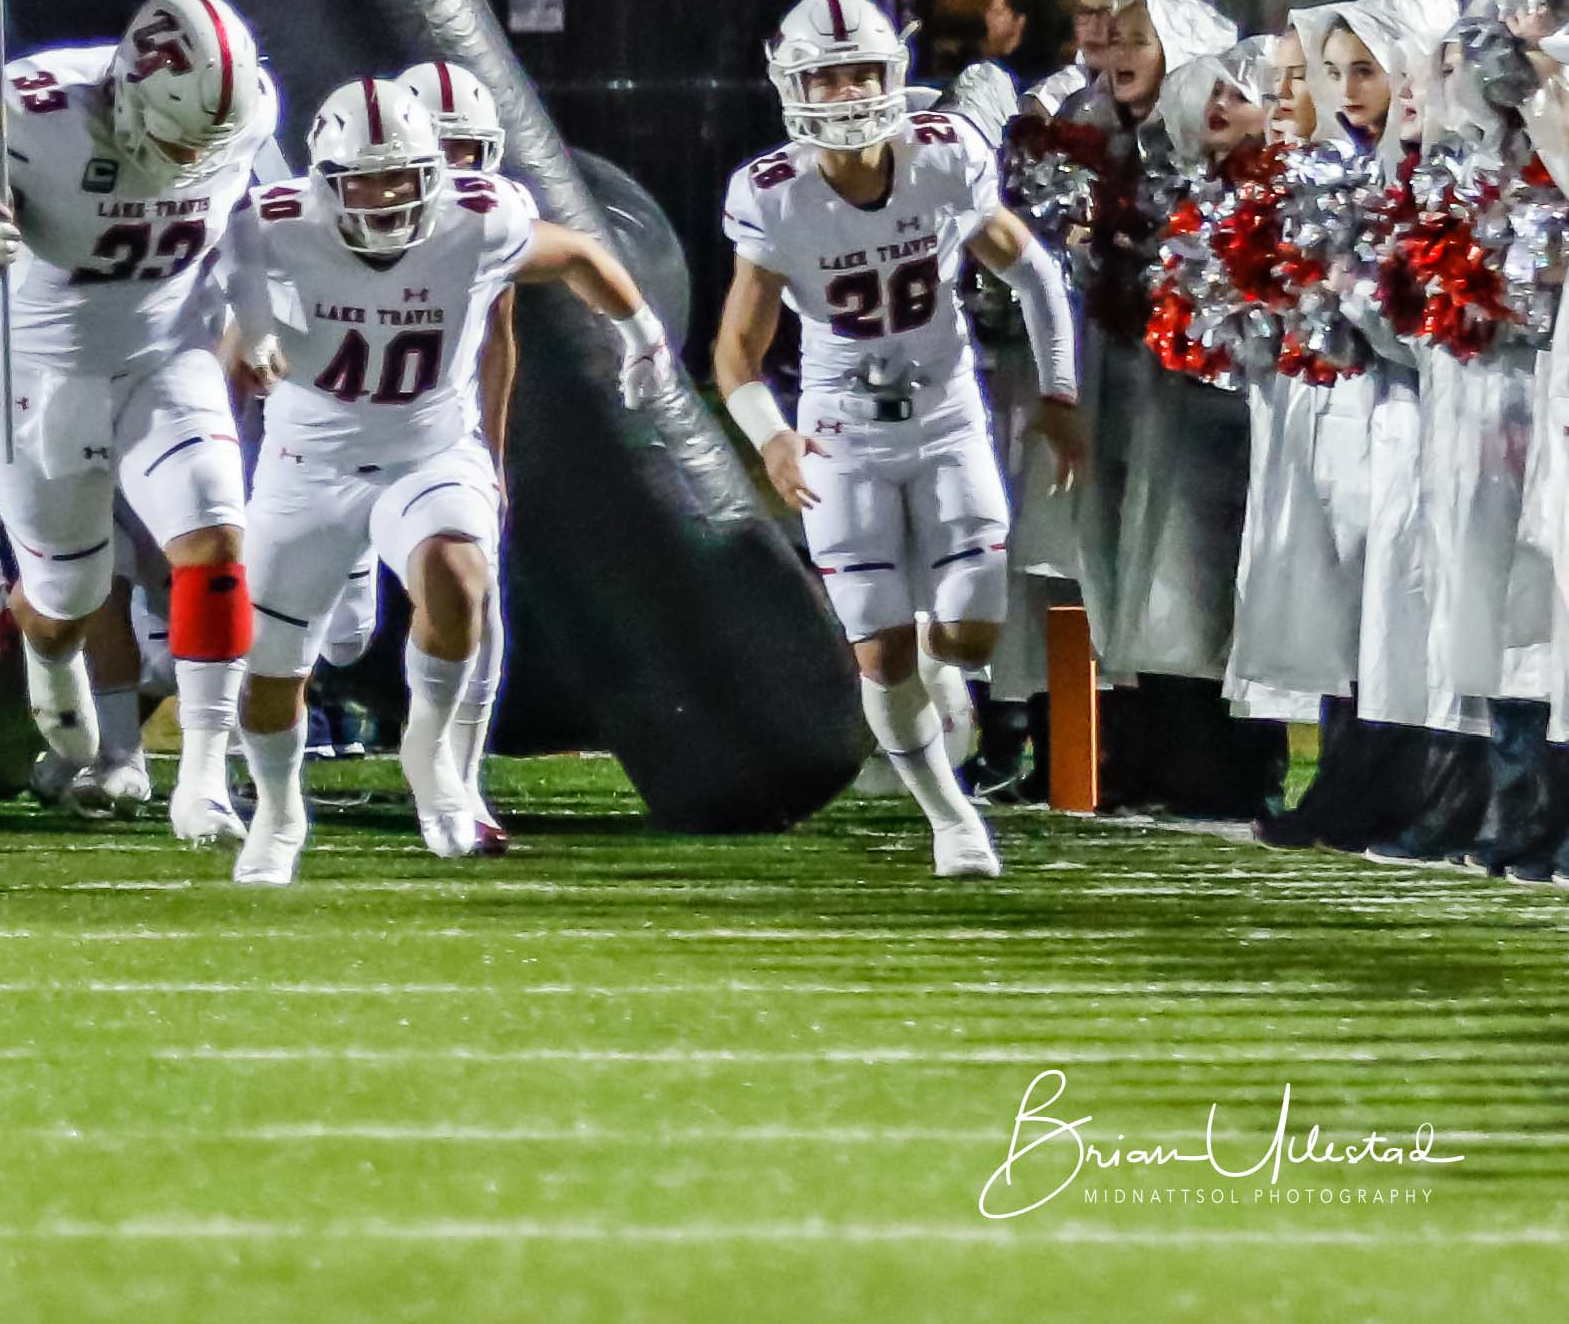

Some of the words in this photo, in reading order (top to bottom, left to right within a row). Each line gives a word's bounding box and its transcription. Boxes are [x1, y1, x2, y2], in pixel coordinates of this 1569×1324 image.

[98, 201, 145, 218] LAKE
[154, 197, 210, 217] TRAVIS
[819, 250, 868, 270] LAKE
[315, 303, 366, 324] LAKE
[377, 309, 445, 326] TRAVIS
[313, 328, 445, 406] 40
